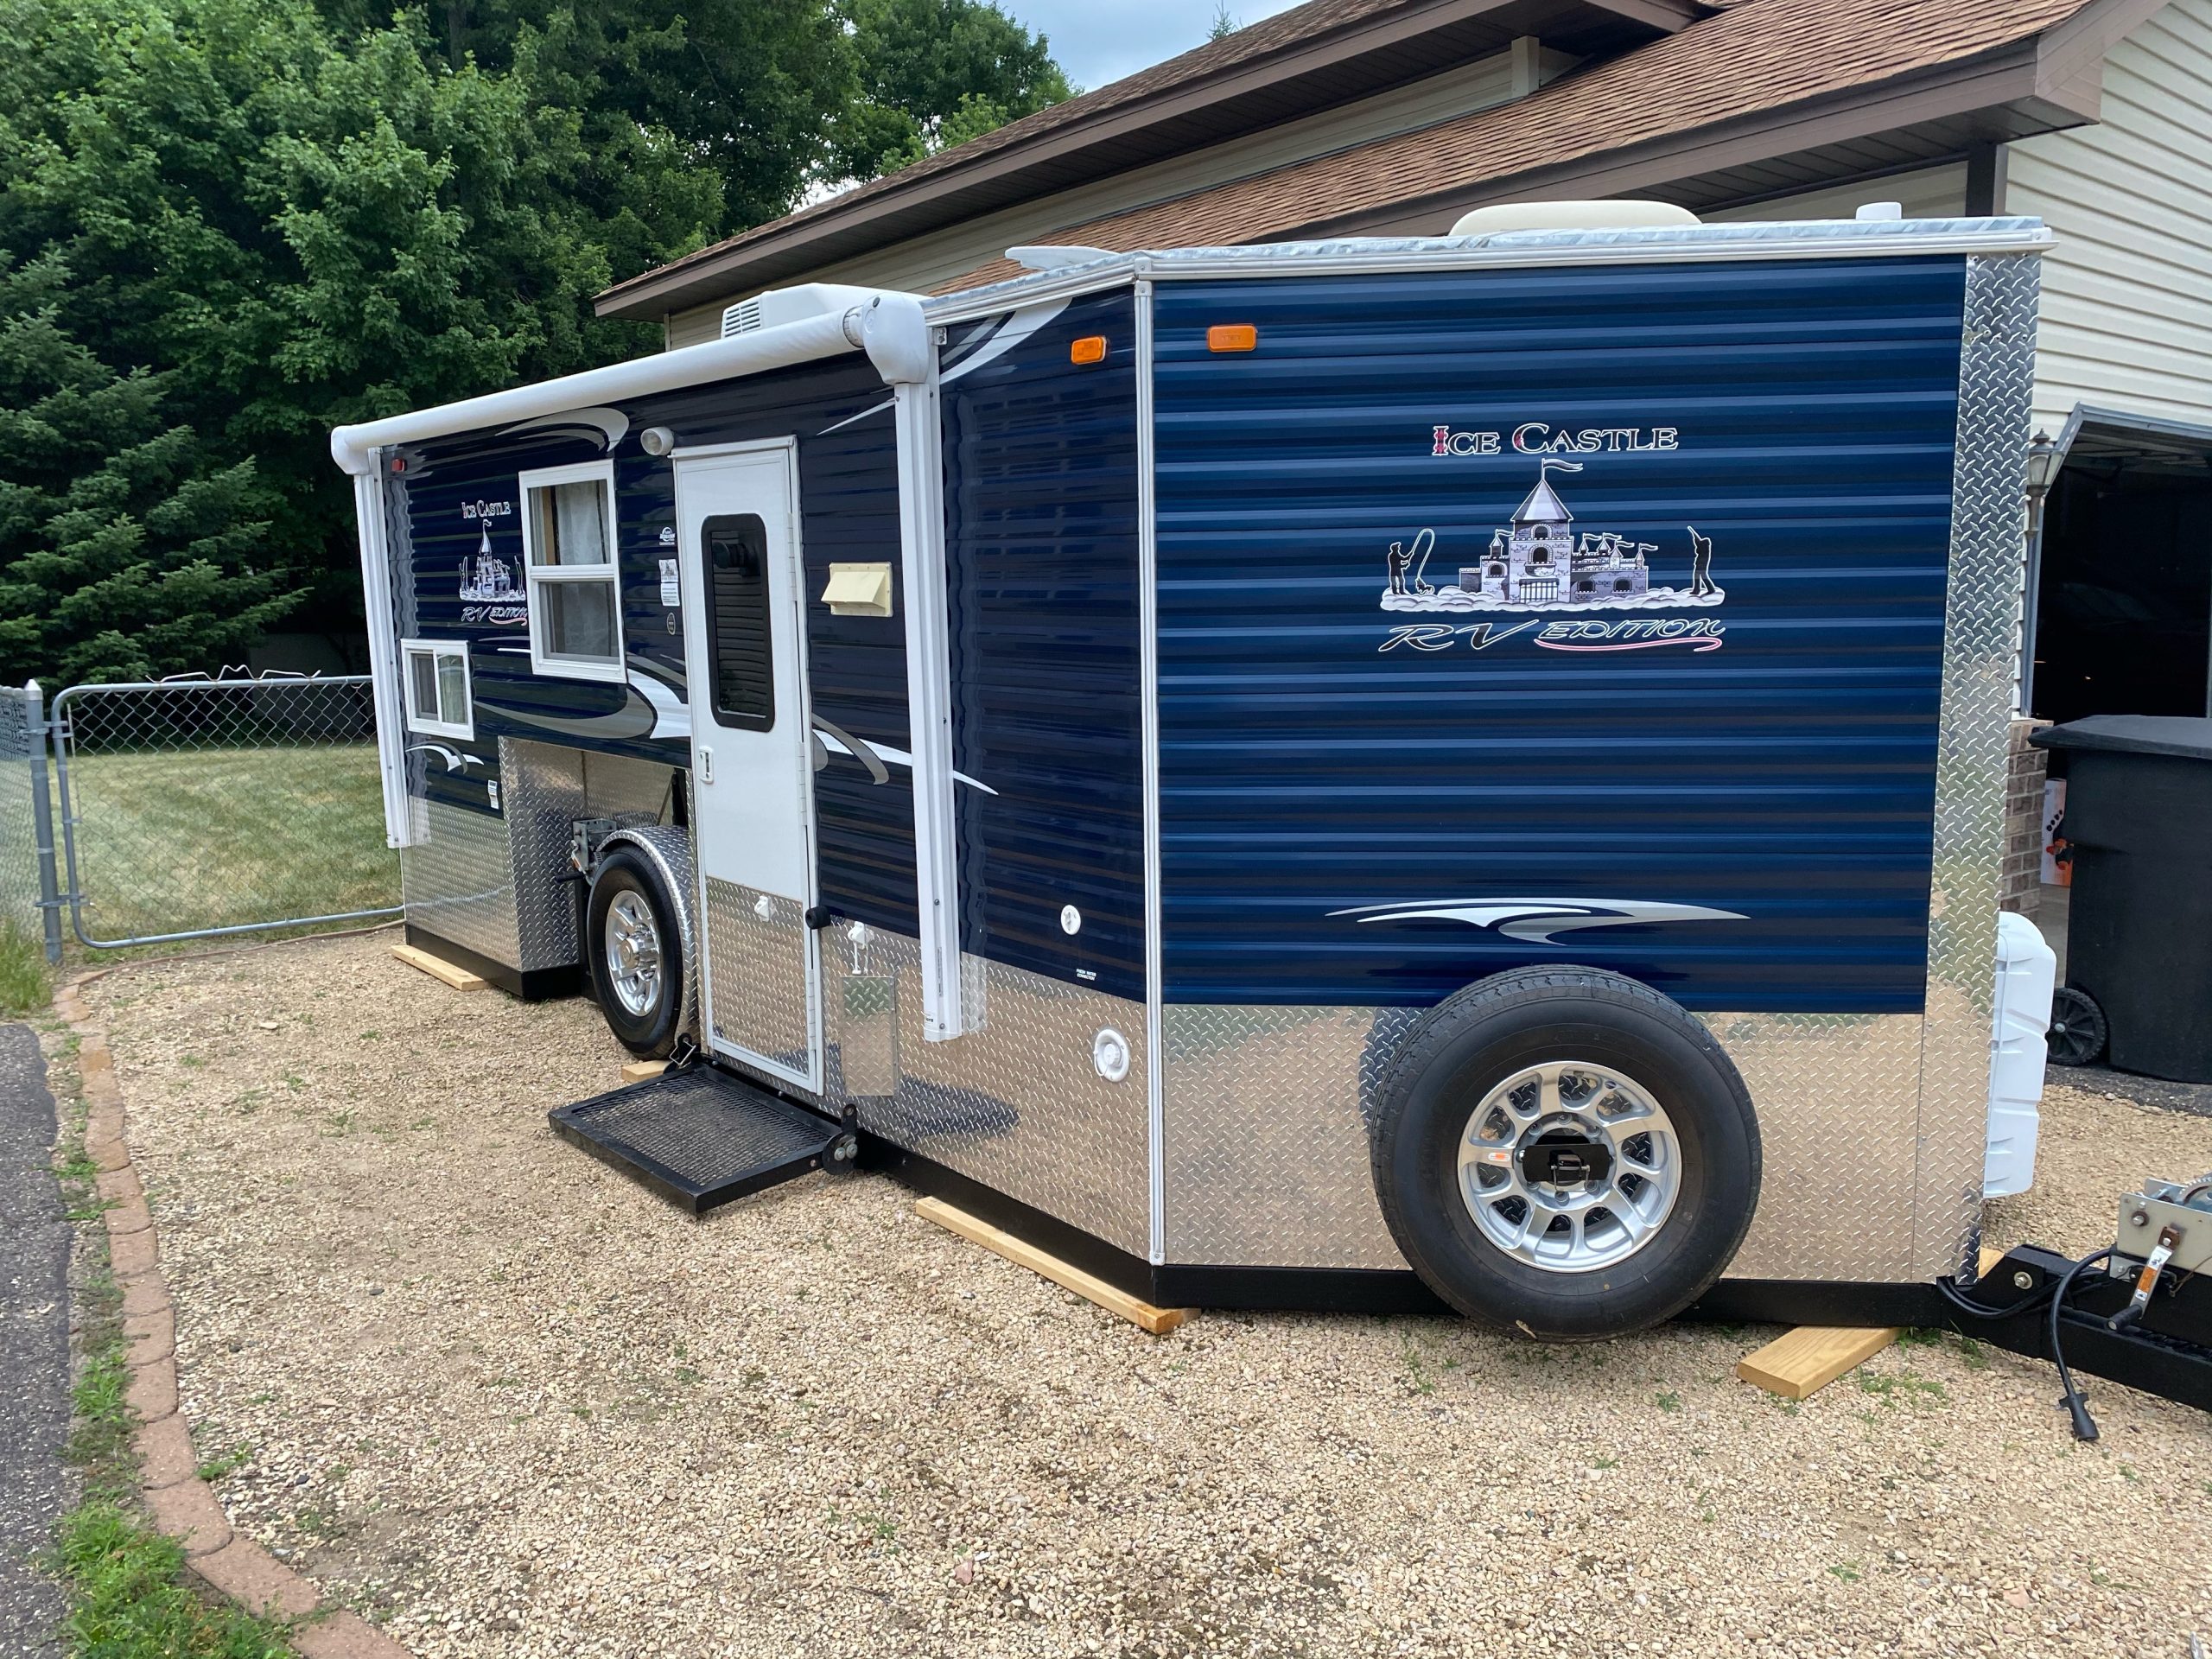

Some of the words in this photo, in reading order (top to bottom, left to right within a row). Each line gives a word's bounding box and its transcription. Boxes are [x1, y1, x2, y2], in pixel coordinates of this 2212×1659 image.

[1432, 424, 1502, 456] ICE
[1512, 423, 1680, 454] CASTLE
[461, 605, 492, 622] RV
[489, 606, 528, 618] EDITION
[1378, 619, 1540, 652] RV
[1538, 618, 1727, 639] EDITION
